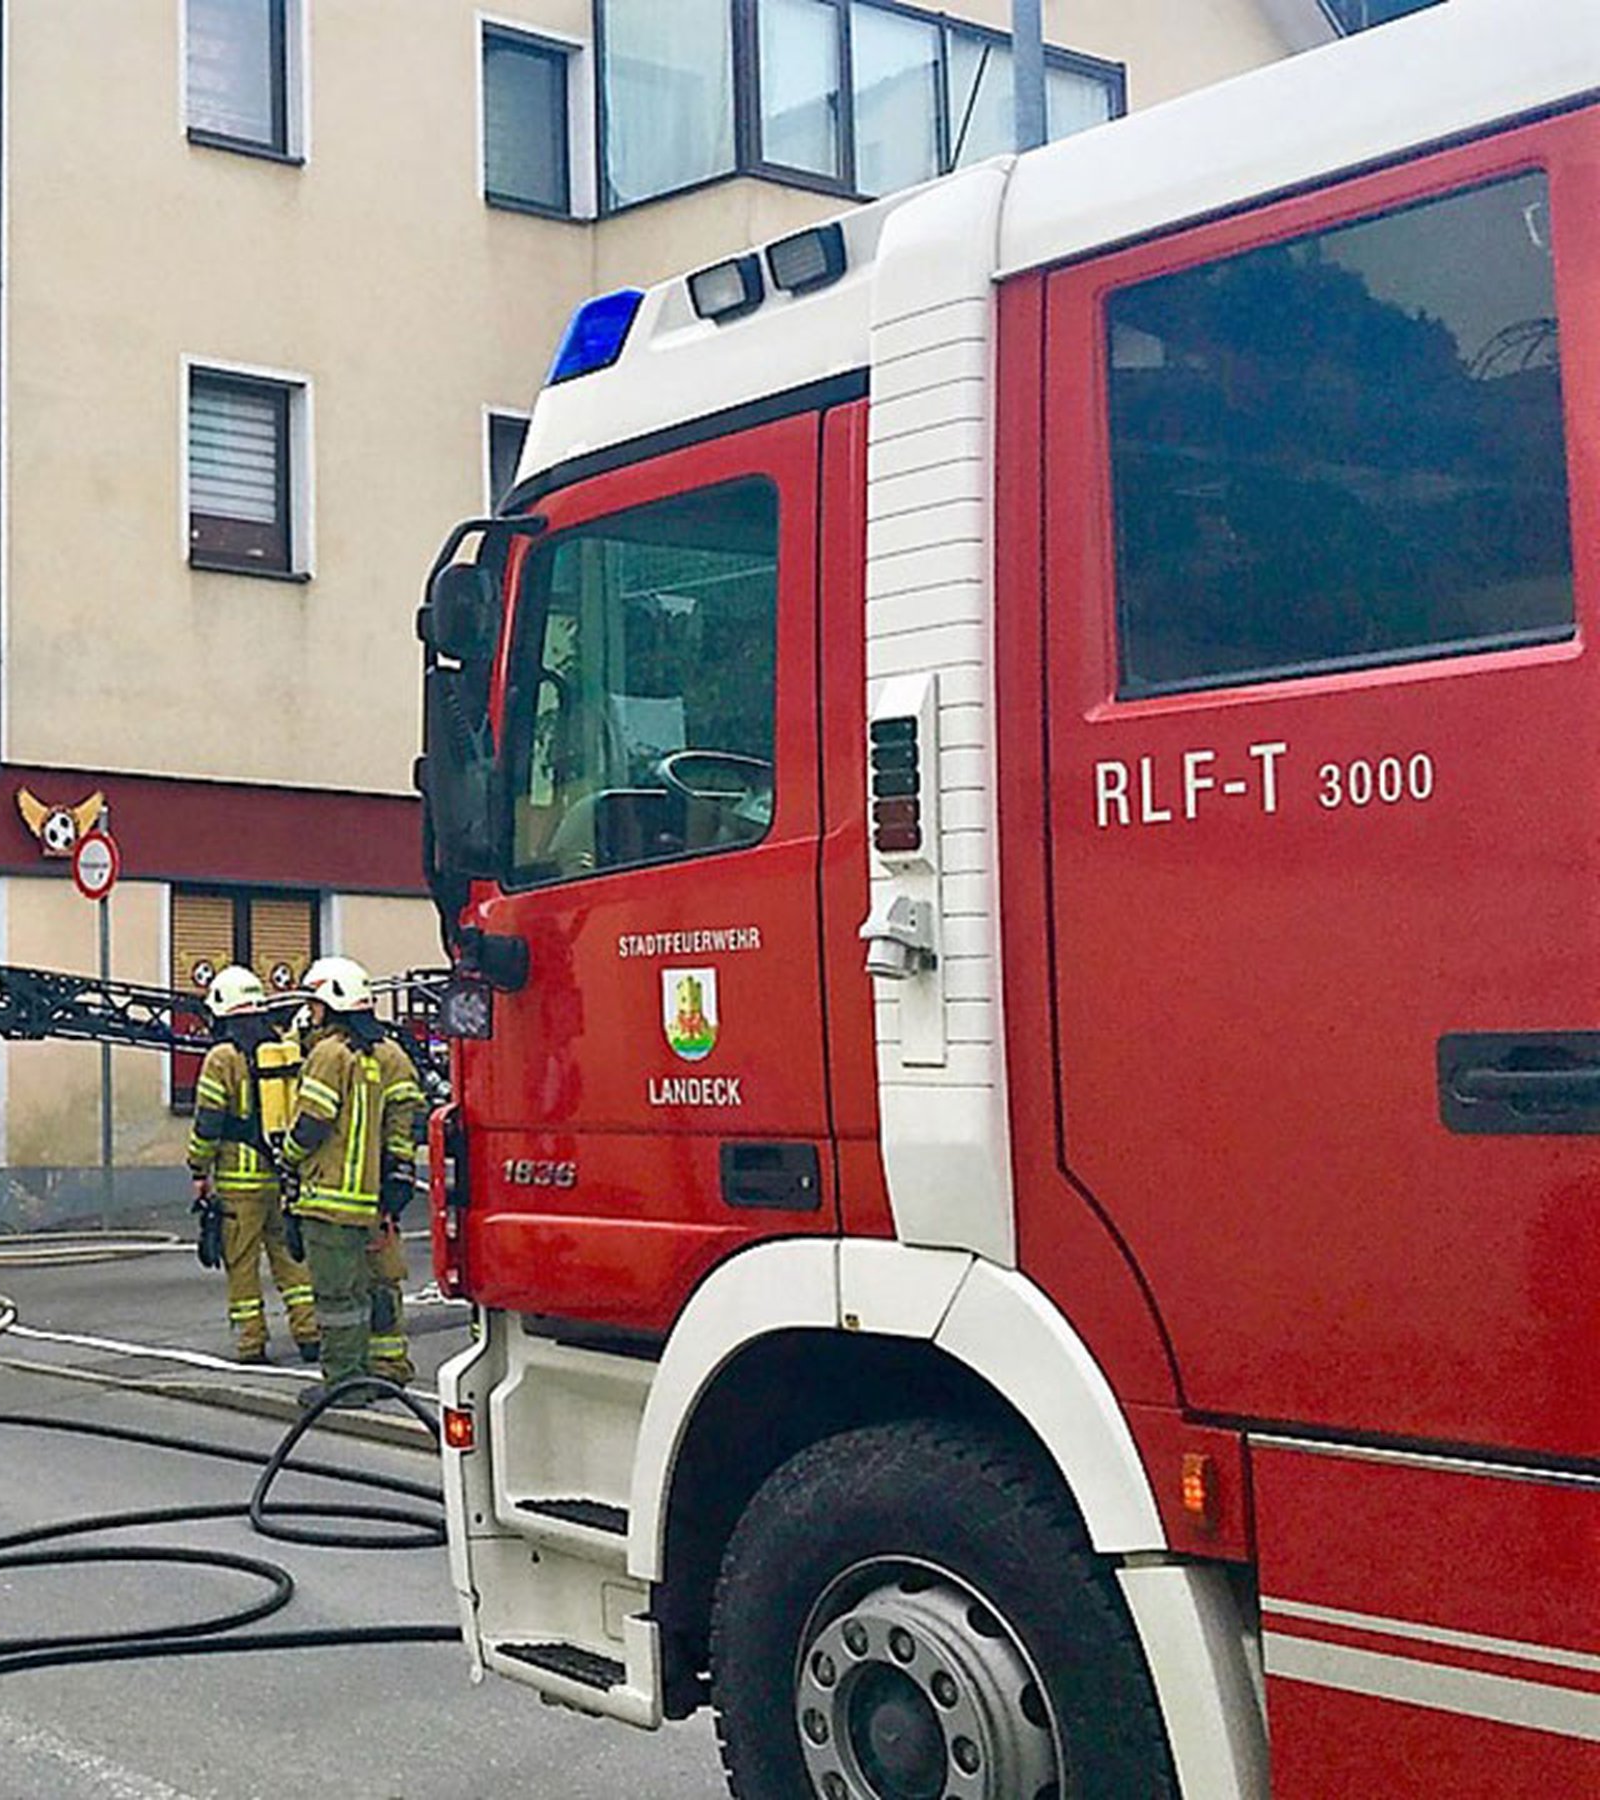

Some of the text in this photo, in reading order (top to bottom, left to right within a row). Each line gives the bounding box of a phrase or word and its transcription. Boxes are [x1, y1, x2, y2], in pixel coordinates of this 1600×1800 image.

[1095, 742, 1433, 827] RLF-T 3000
[618, 927, 761, 958] STADTFEUERWEHR
[648, 1077, 742, 1105] LANDECK
[501, 1158, 577, 1188] 1836
